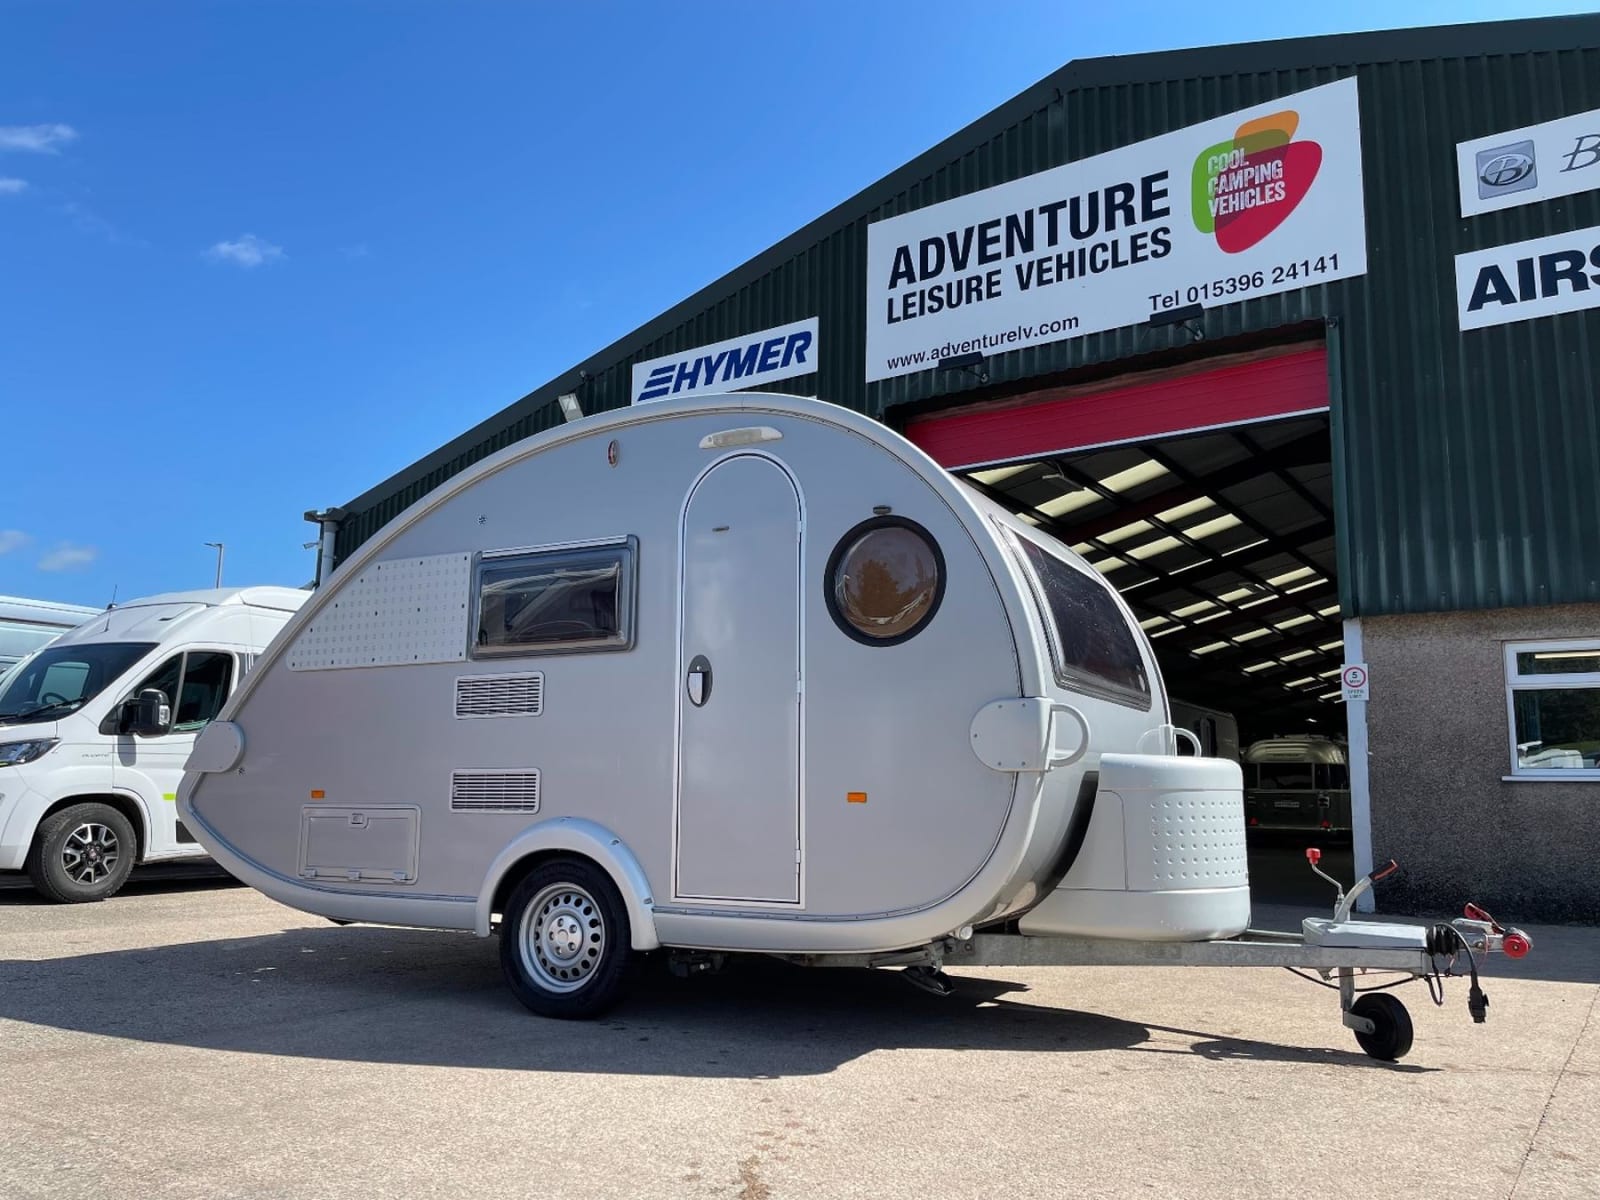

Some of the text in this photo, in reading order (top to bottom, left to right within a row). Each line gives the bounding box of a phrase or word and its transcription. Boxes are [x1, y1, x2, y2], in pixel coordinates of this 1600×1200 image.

[1207, 148, 1249, 175] COOL
[1207, 160, 1283, 197] CAMPING
[1208, 181, 1286, 217] VEHICLES
[888, 170, 1170, 290] ADVENTURE
[887, 226, 1172, 324] LEISURE VEHICLES
[1148, 253, 1339, 311] Tel 015396 24141
[1467, 245, 1600, 312] AIR
[672, 331, 812, 393] HYMER
[887, 316, 1079, 370] www.adventurelv.com
[1351, 671, 1358, 679] 5
